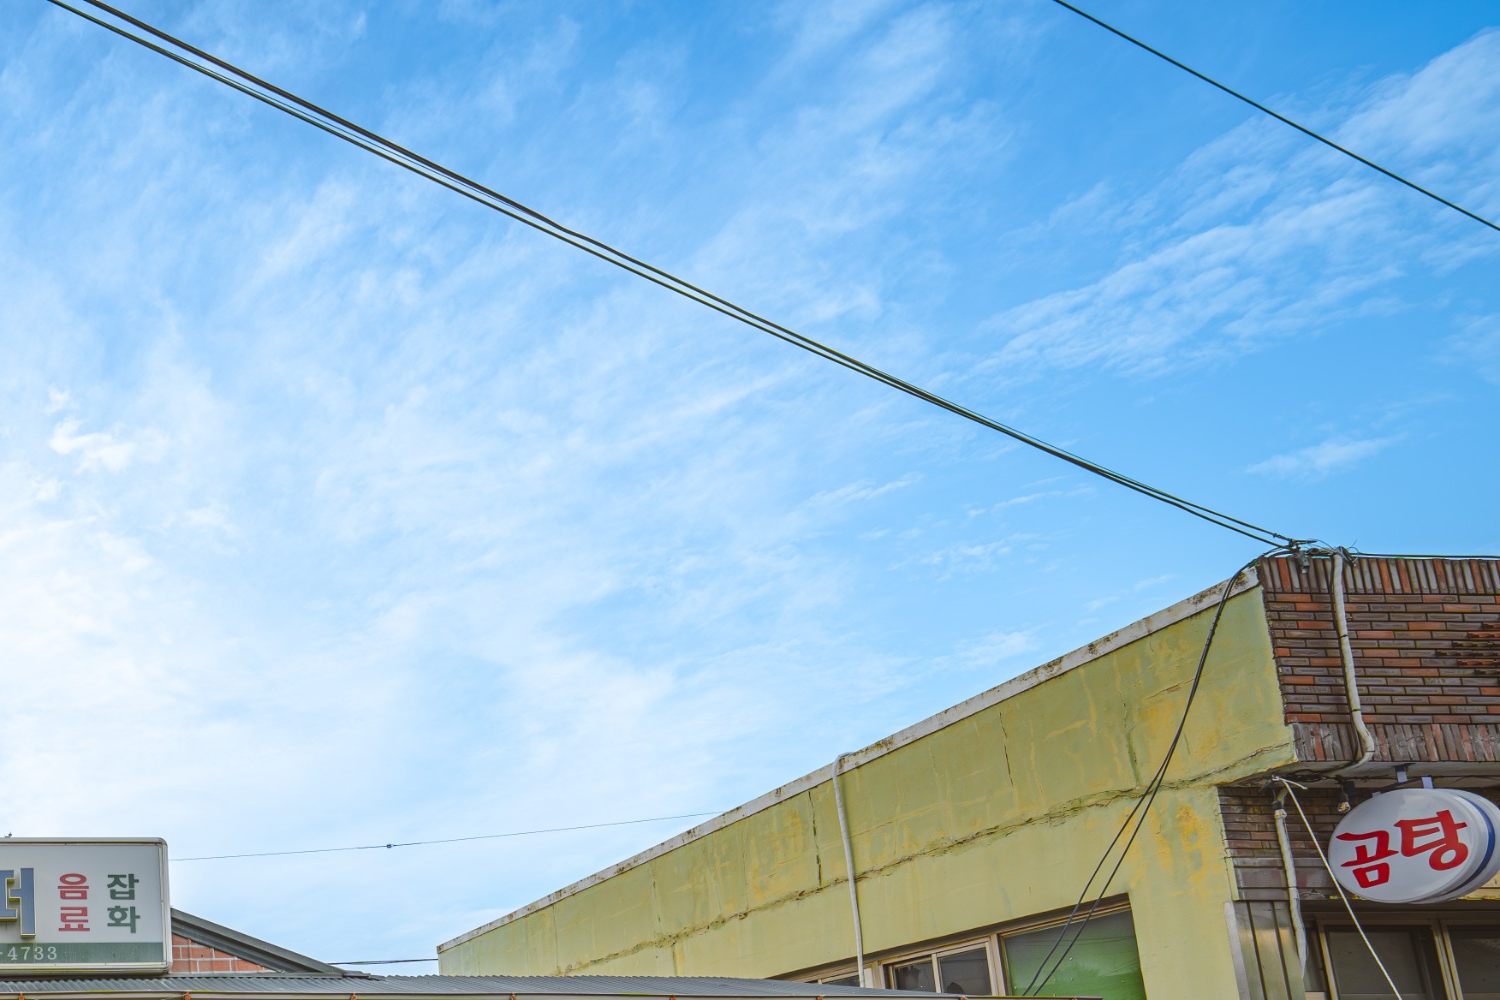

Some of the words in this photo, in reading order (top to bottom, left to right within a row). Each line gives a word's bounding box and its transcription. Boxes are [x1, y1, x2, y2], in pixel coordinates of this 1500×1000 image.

[1336, 810, 1468, 888] 곰탕
[58, 873, 90, 932] 음료
[107, 873, 140, 933] 잡화
